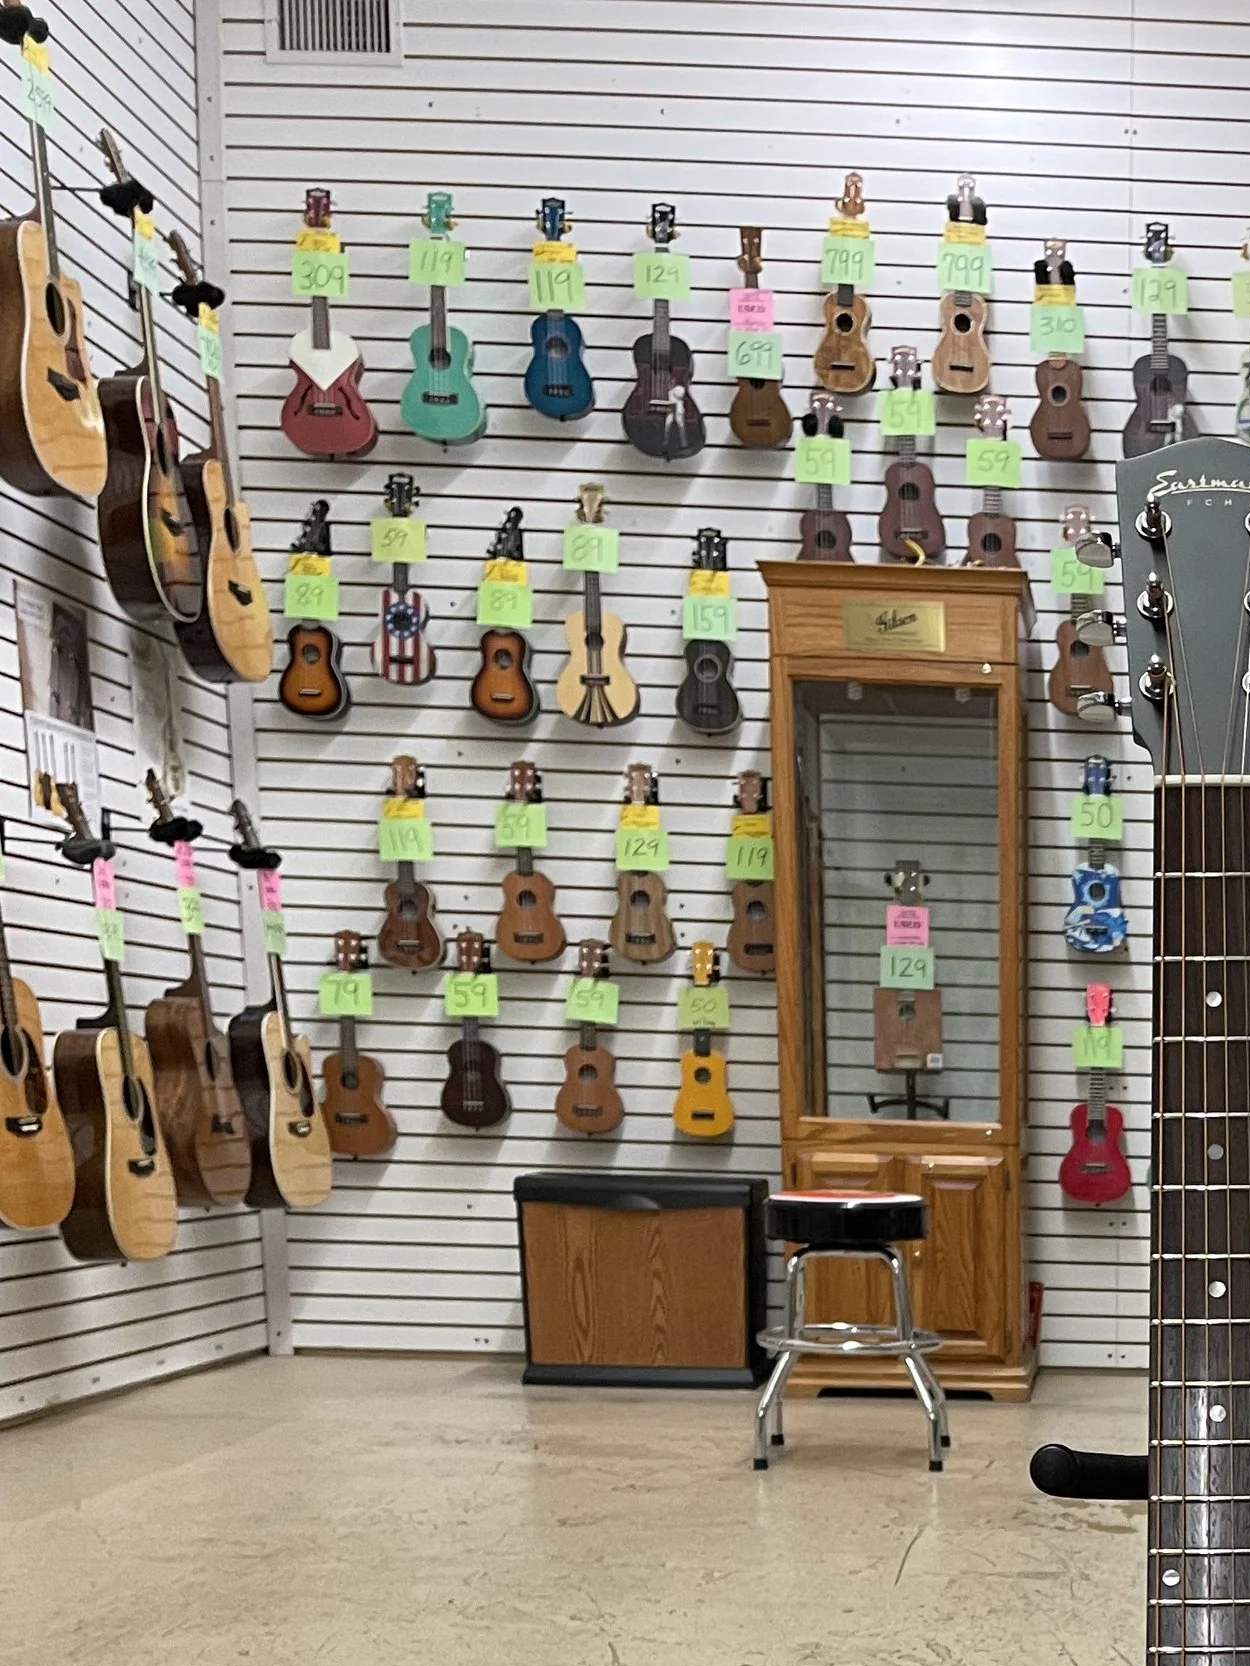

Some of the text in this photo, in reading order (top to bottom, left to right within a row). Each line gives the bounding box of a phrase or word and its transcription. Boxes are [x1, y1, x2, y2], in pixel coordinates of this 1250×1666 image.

[420, 249, 453, 272] 119
[645, 265, 680, 283] 129
[825, 249, 864, 280] 799
[942, 253, 985, 287] 799
[300, 260, 345, 295] 309
[535, 269, 573, 302] 119
[1139, 279, 1178, 309] 129
[736, 340, 774, 370] 699
[890, 400, 921, 429] 59
[804, 448, 836, 478] 59
[977, 449, 1010, 473] 59
[380, 527, 409, 548] 59
[571, 534, 603, 562] 89
[1060, 560, 1094, 590] 59
[489, 589, 518, 612] 89
[692, 602, 729, 633] 159
[503, 813, 530, 840] 59
[1080, 802, 1112, 828] 50
[389, 826, 424, 853] 119
[624, 837, 660, 857] 129
[737, 846, 768, 869] 119
[891, 955, 926, 979] 129
[326, 979, 358, 1005] 79
[453, 981, 487, 1008] 59
[576, 989, 604, 1009] 59
